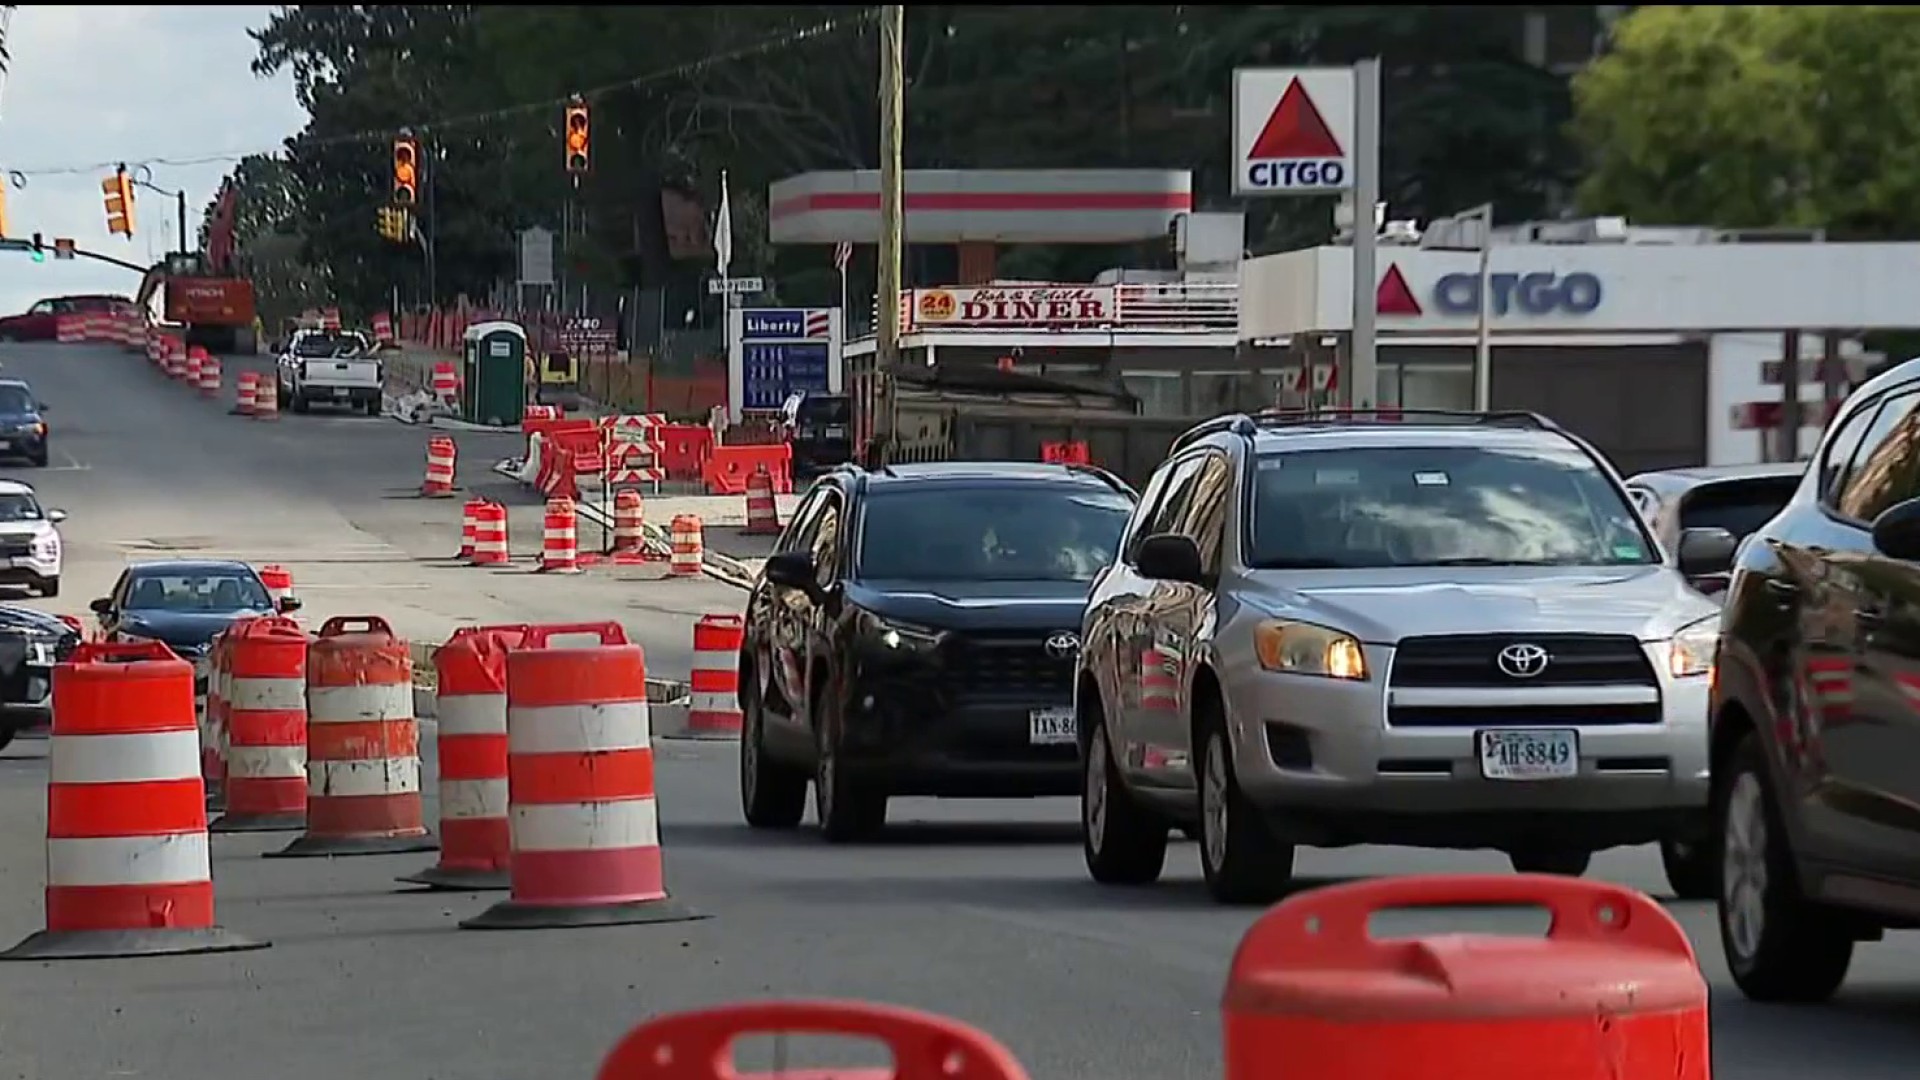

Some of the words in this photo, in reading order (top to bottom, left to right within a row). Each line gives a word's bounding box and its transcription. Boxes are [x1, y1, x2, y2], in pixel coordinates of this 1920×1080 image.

[1248, 161, 1344, 186] CITGO
[923, 293, 951, 309] 24
[961, 300, 1106, 320] DINER
[747, 318, 801, 334] Liberty
